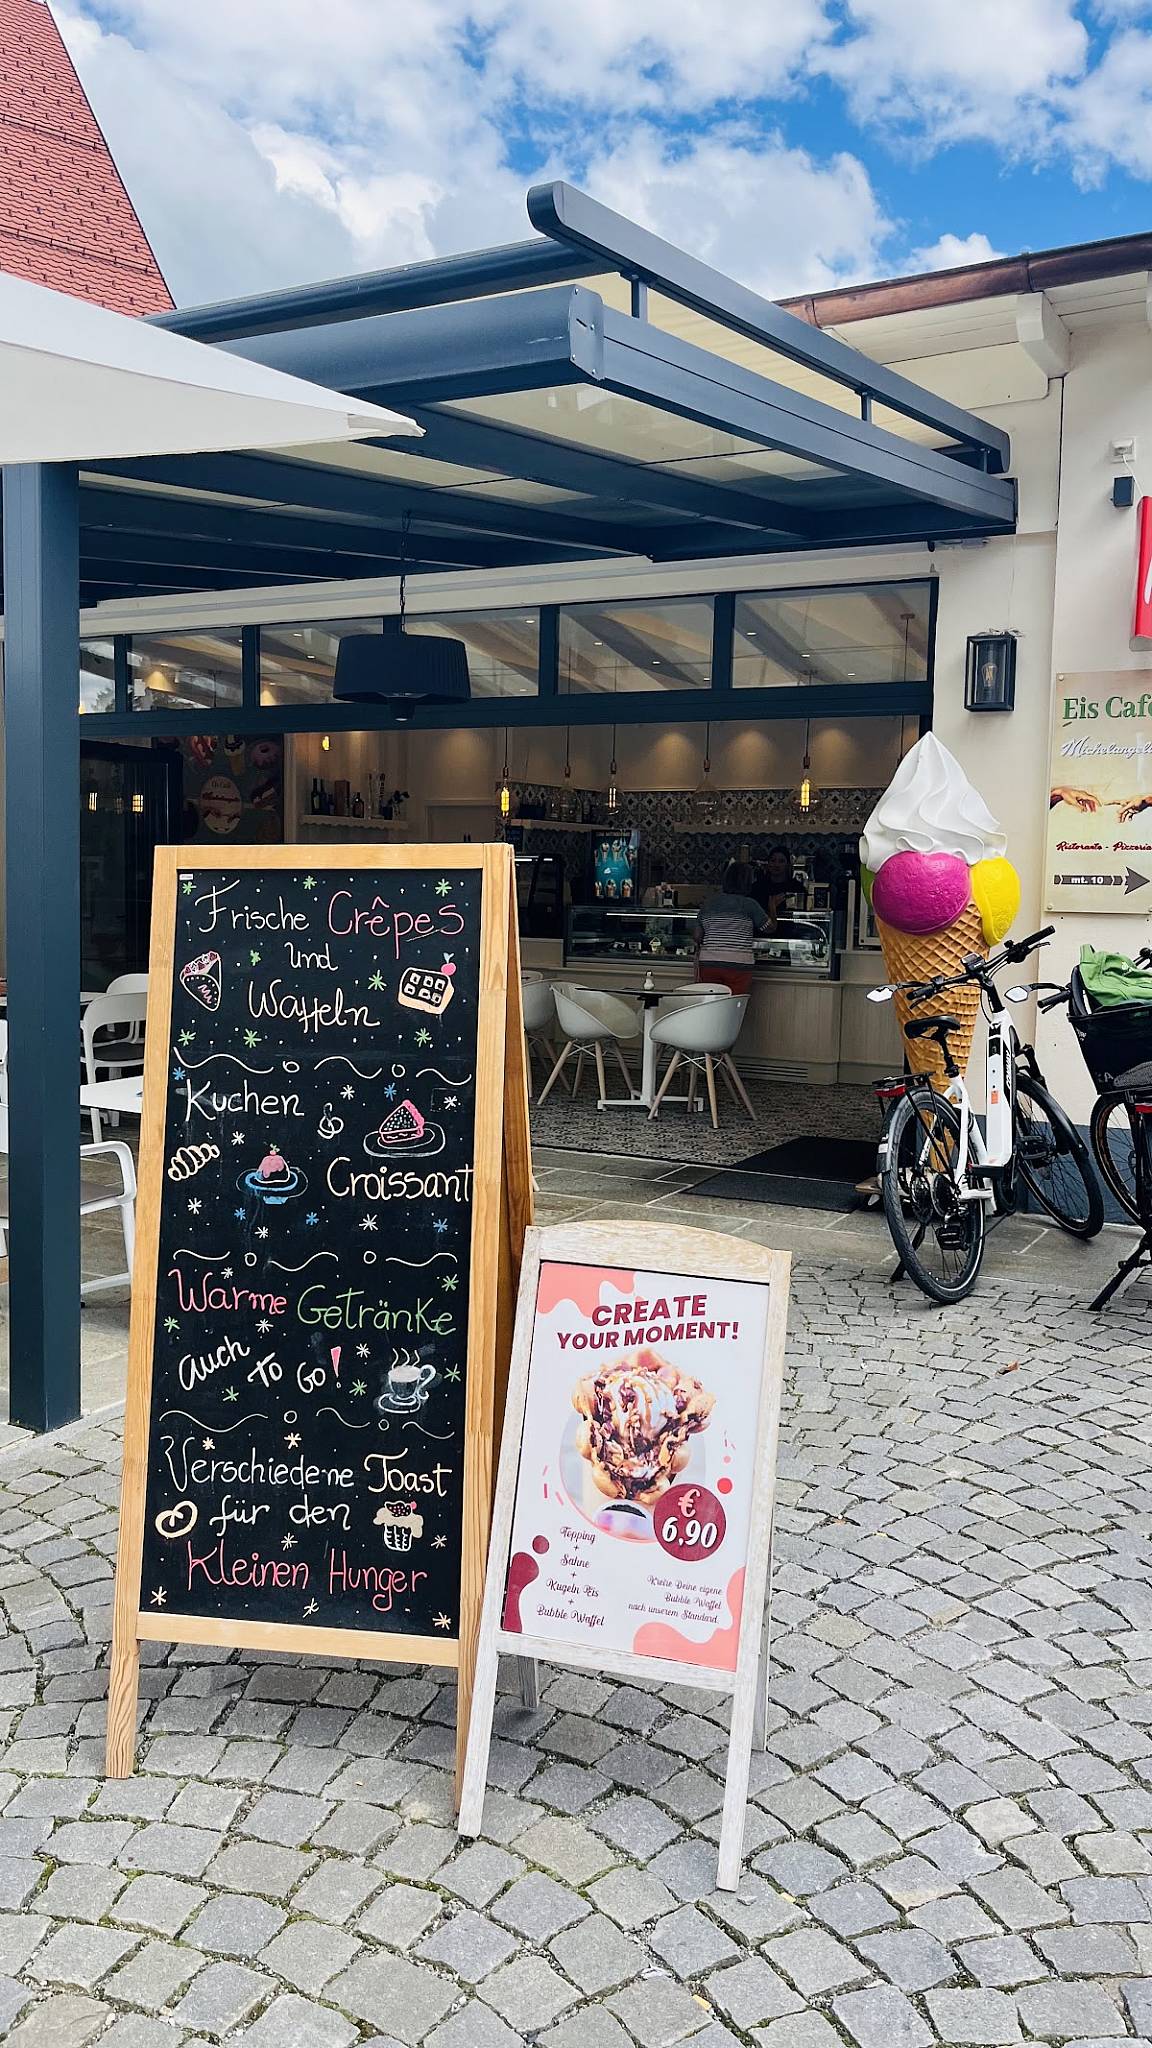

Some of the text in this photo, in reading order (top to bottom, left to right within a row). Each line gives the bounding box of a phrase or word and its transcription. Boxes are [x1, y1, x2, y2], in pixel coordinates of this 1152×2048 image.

[1062, 696, 1099, 720] Eis
[1056, 840, 1102, 852] Ristorante
[1090, 876, 1104, 884] 10
[194, 879, 465, 959] Frische Crêpes
[248, 979, 381, 1034] Waffeln
[185, 1078, 305, 1121] Kuchen
[326, 1157, 475, 1202] Croissant
[168, 1268, 288, 1316] Warme
[591, 1294, 708, 1327] CREATE
[556, 1321, 739, 1350] YOUR MOMENT!
[247, 1352, 283, 1388] To
[160, 1436, 453, 1497] Verschiedene Toast
[208, 1494, 351, 1537] für den
[677, 1488, 701, 1518] €
[559, 1526, 597, 1545] Topping
[661, 1516, 719, 1549] 6,90
[187, 1538, 428, 1611] Kleinen Hunger
[560, 1554, 591, 1569] Sahne
[545, 1579, 600, 1598] Kugeln Eis
[674, 1578, 698, 1593] Deine
[699, 1584, 724, 1598] eigene
[536, 1603, 607, 1628] Bubble Waffel
[627, 1602, 647, 1613] nach
[647, 1605, 679, 1618] unserem
